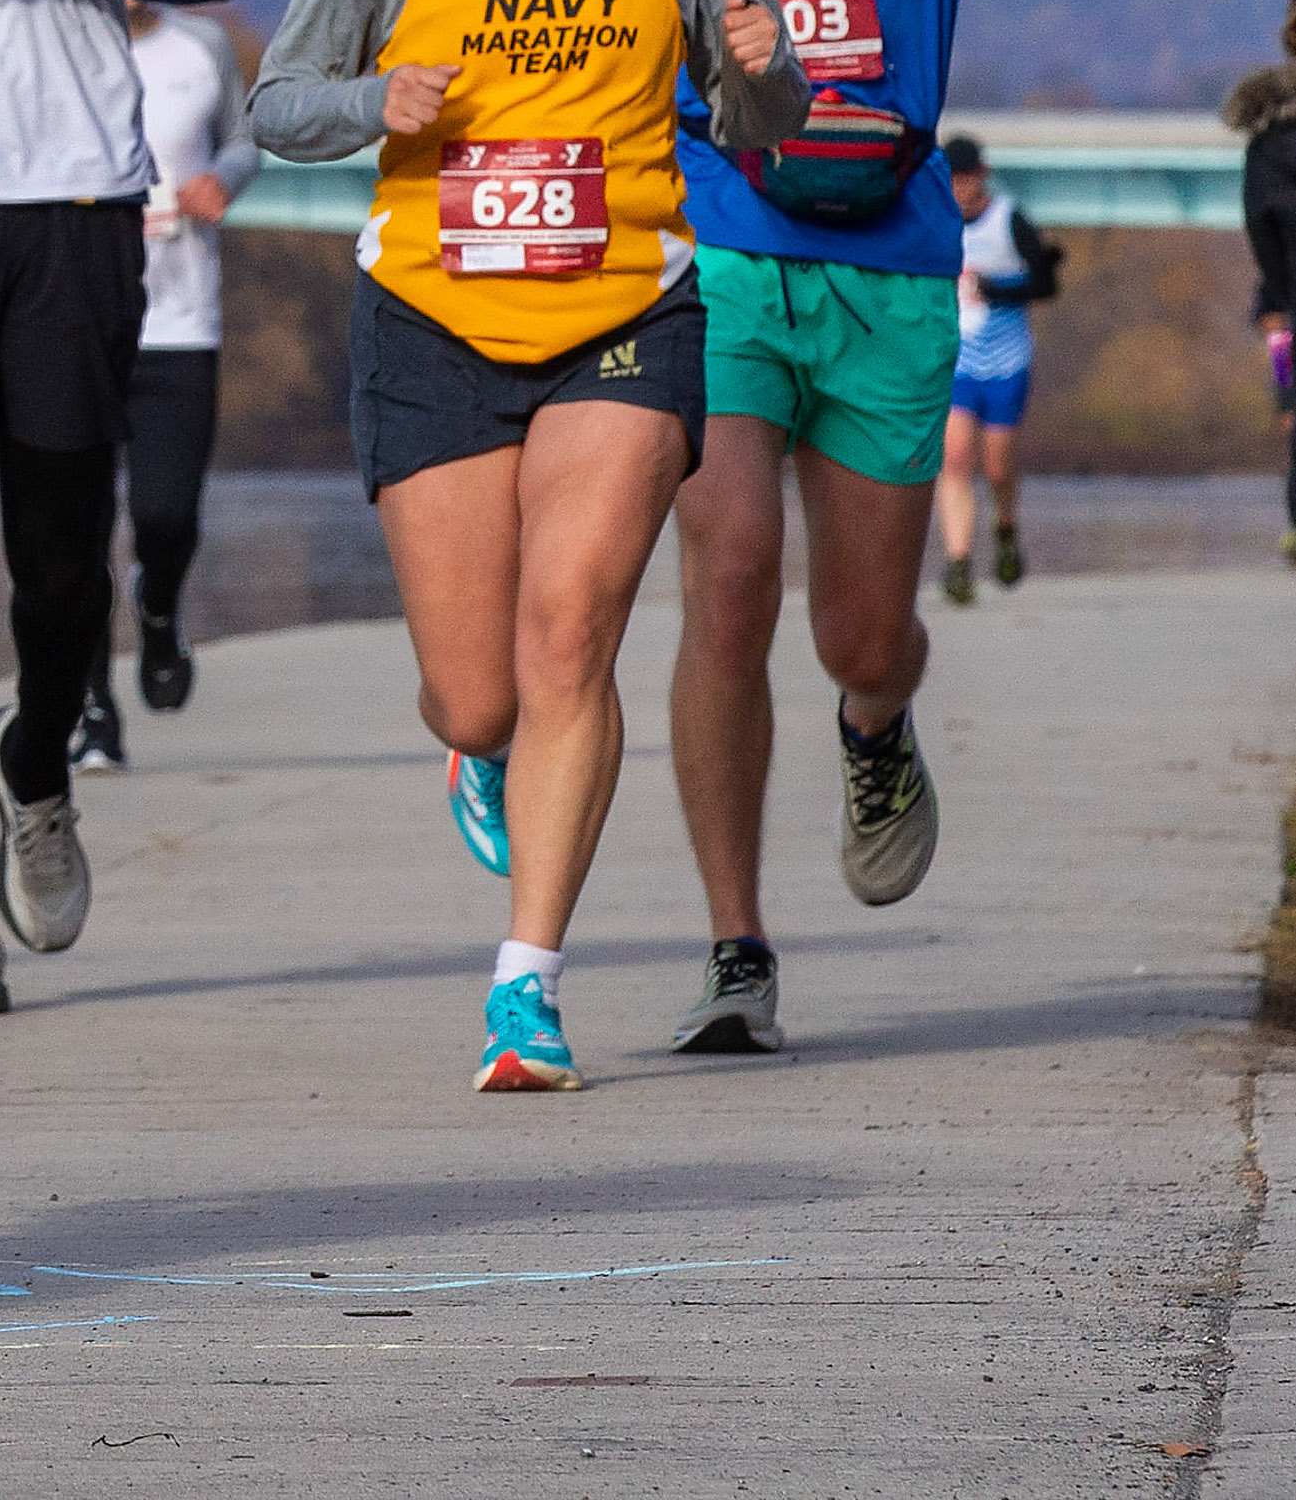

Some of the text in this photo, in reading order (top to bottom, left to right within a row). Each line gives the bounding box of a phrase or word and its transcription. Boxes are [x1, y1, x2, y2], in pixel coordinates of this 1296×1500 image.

[461, 25, 638, 55] MARATHON
[507, 50, 589, 74] TEAM
[472, 180, 575, 227] 628
